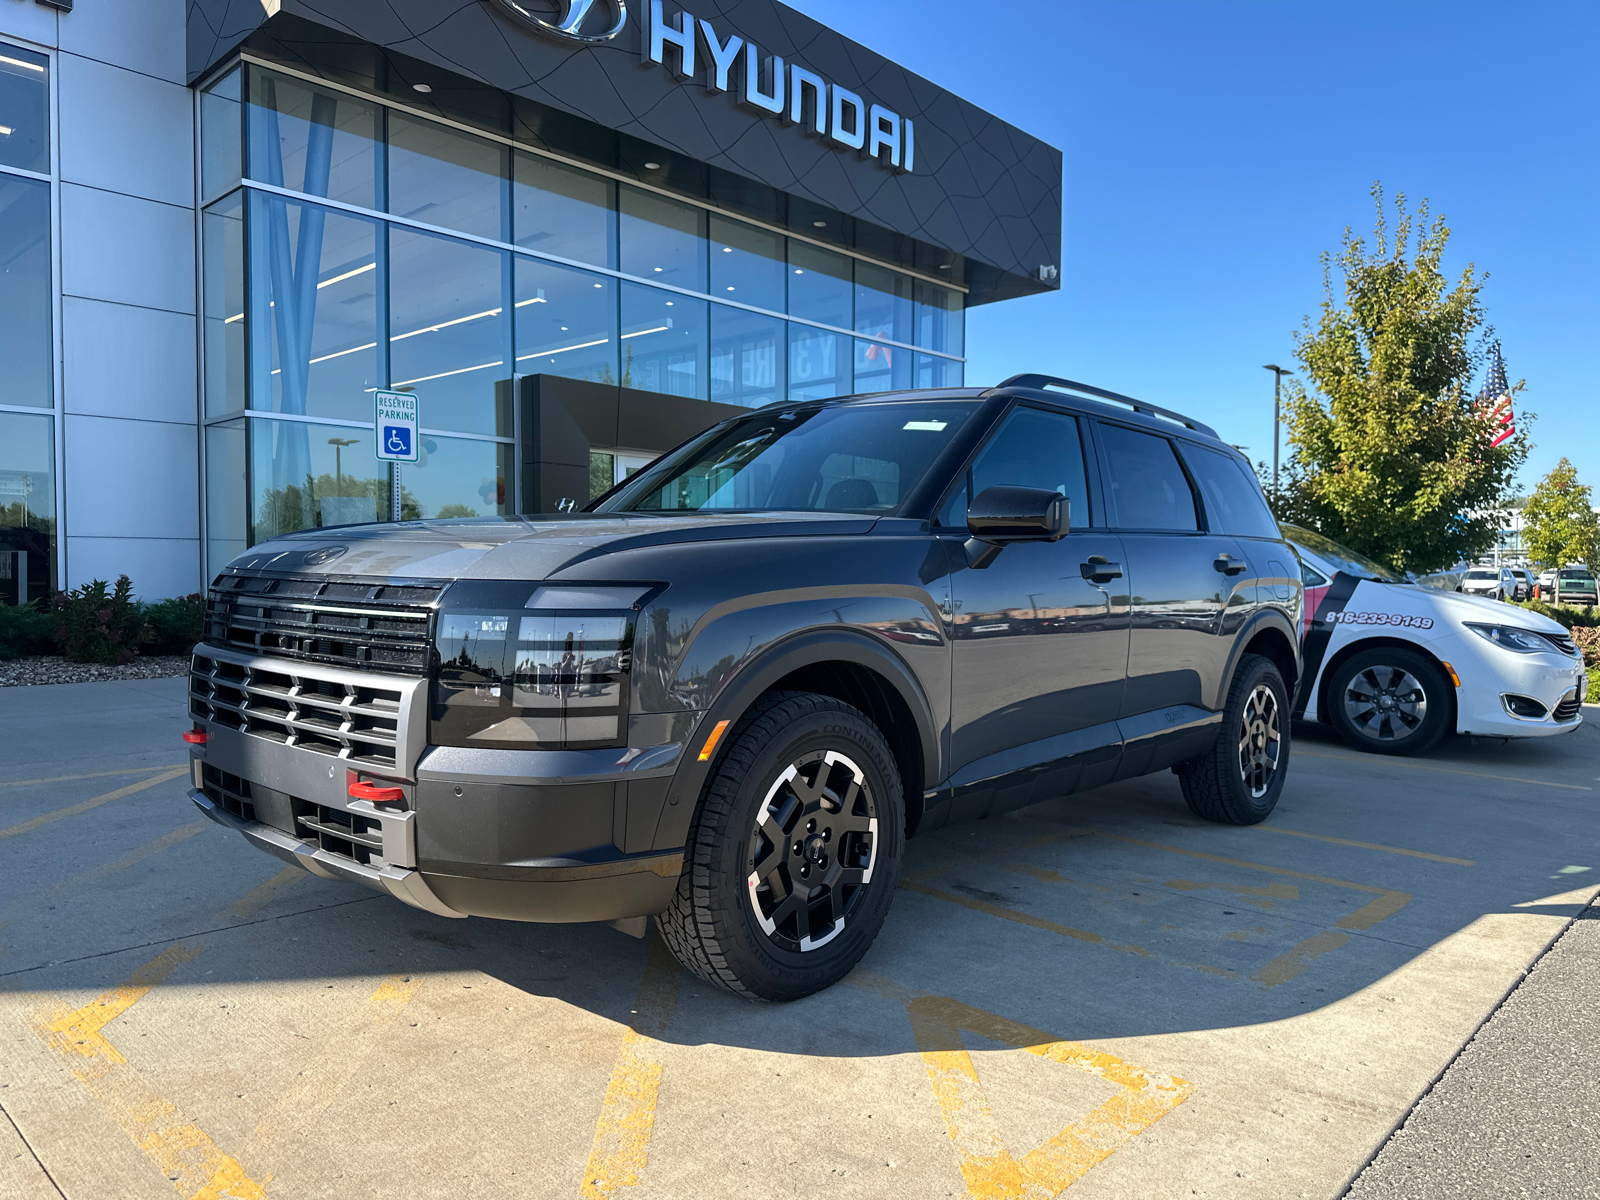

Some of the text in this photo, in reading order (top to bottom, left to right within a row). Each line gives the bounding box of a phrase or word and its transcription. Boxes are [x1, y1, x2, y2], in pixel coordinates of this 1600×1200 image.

[649, 0, 914, 173] HYUNDAI
[378, 397, 415, 410] RESERVED
[378, 409, 415, 422] PARKING
[1325, 611, 1434, 629] 816-233-9149
[823, 724, 894, 790] CONTINENTAL
